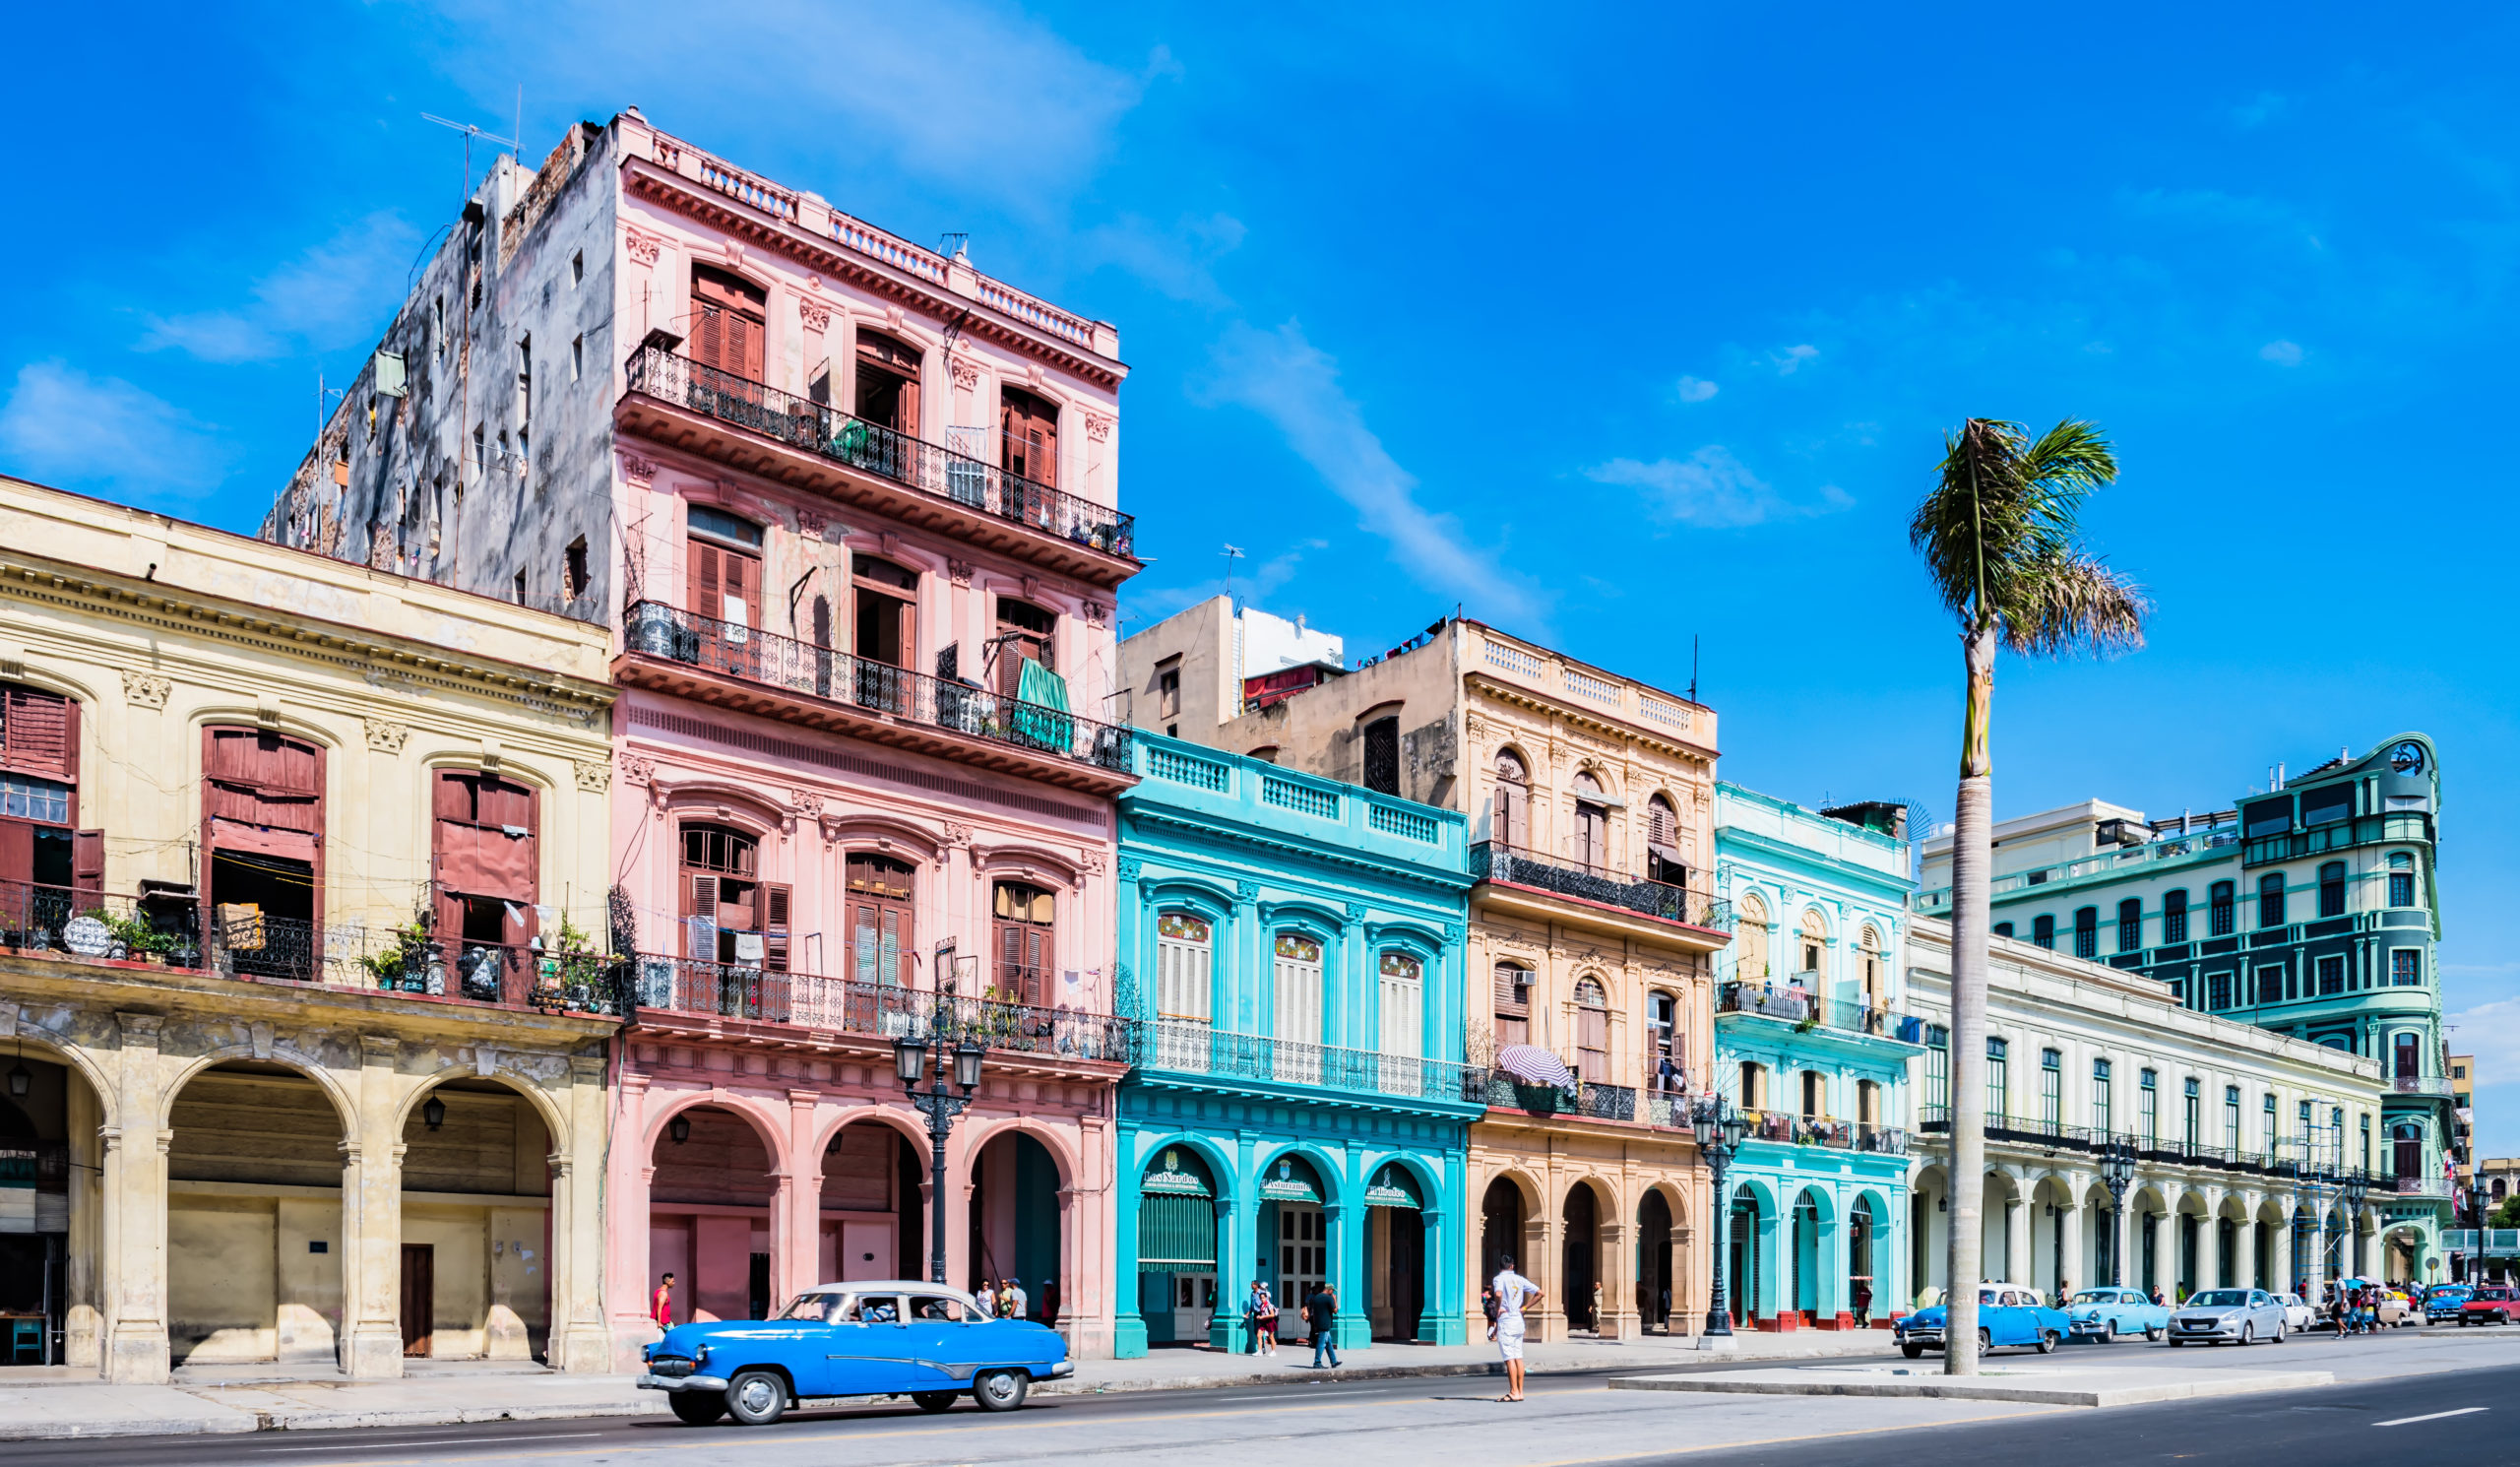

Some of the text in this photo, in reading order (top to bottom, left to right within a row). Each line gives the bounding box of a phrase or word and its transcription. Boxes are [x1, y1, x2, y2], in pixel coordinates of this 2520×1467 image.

[1144, 1171, 1199, 1184] Los Nardos
[1268, 1179, 1311, 1191] Asturianito
